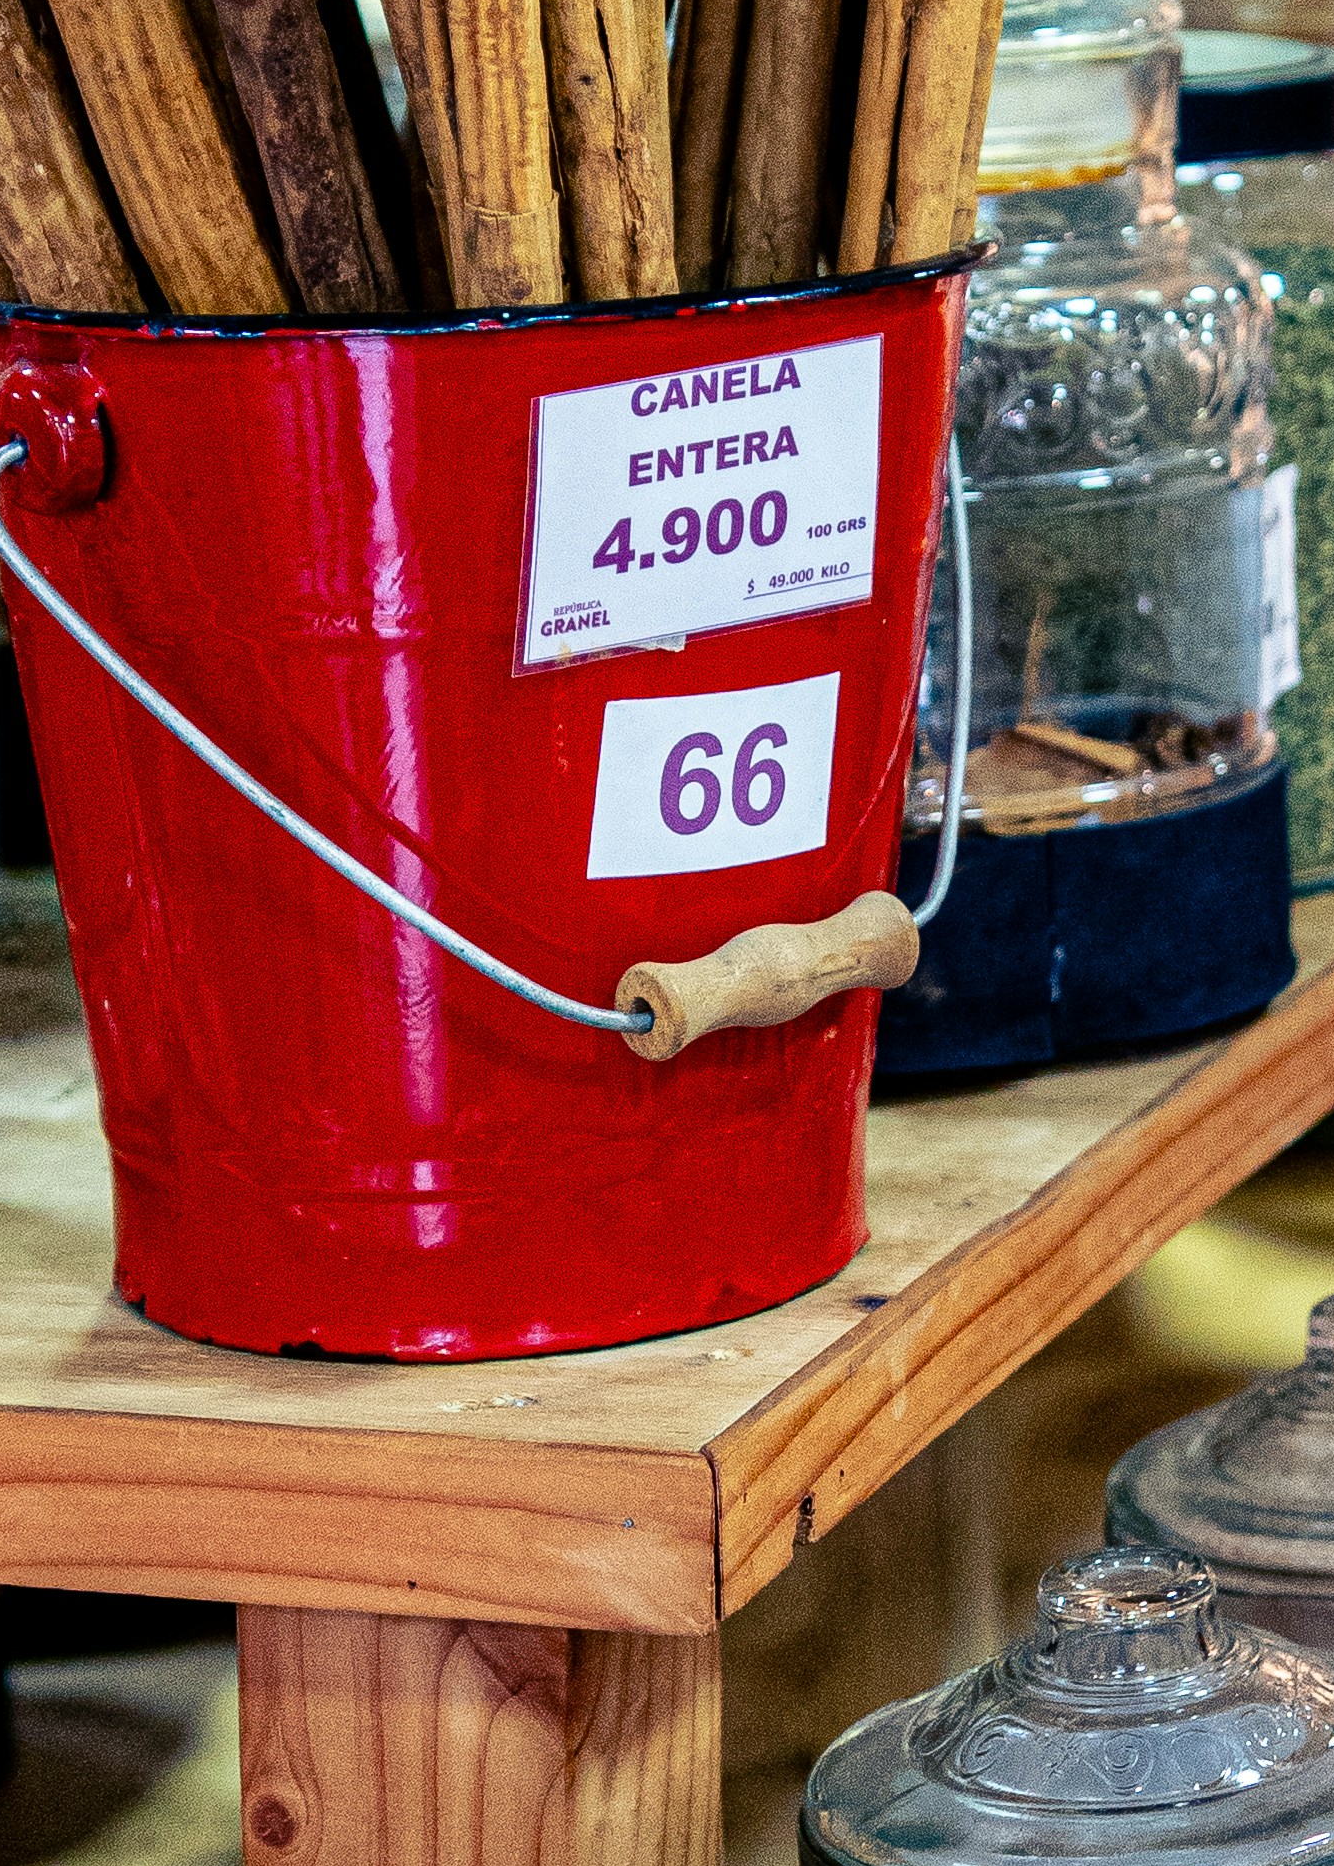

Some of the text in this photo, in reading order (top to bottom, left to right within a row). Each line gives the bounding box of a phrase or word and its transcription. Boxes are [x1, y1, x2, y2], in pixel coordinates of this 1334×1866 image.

[630, 357, 801, 417] CANELA
[628, 425, 799, 487] ENTERA
[592, 489, 788, 575] 4.900
[806, 516, 867, 540] 100 GRS
[747, 561, 851, 594] $ 49.000 KILO
[540, 609, 611, 636] GRANEL
[659, 722, 788, 836] 66
